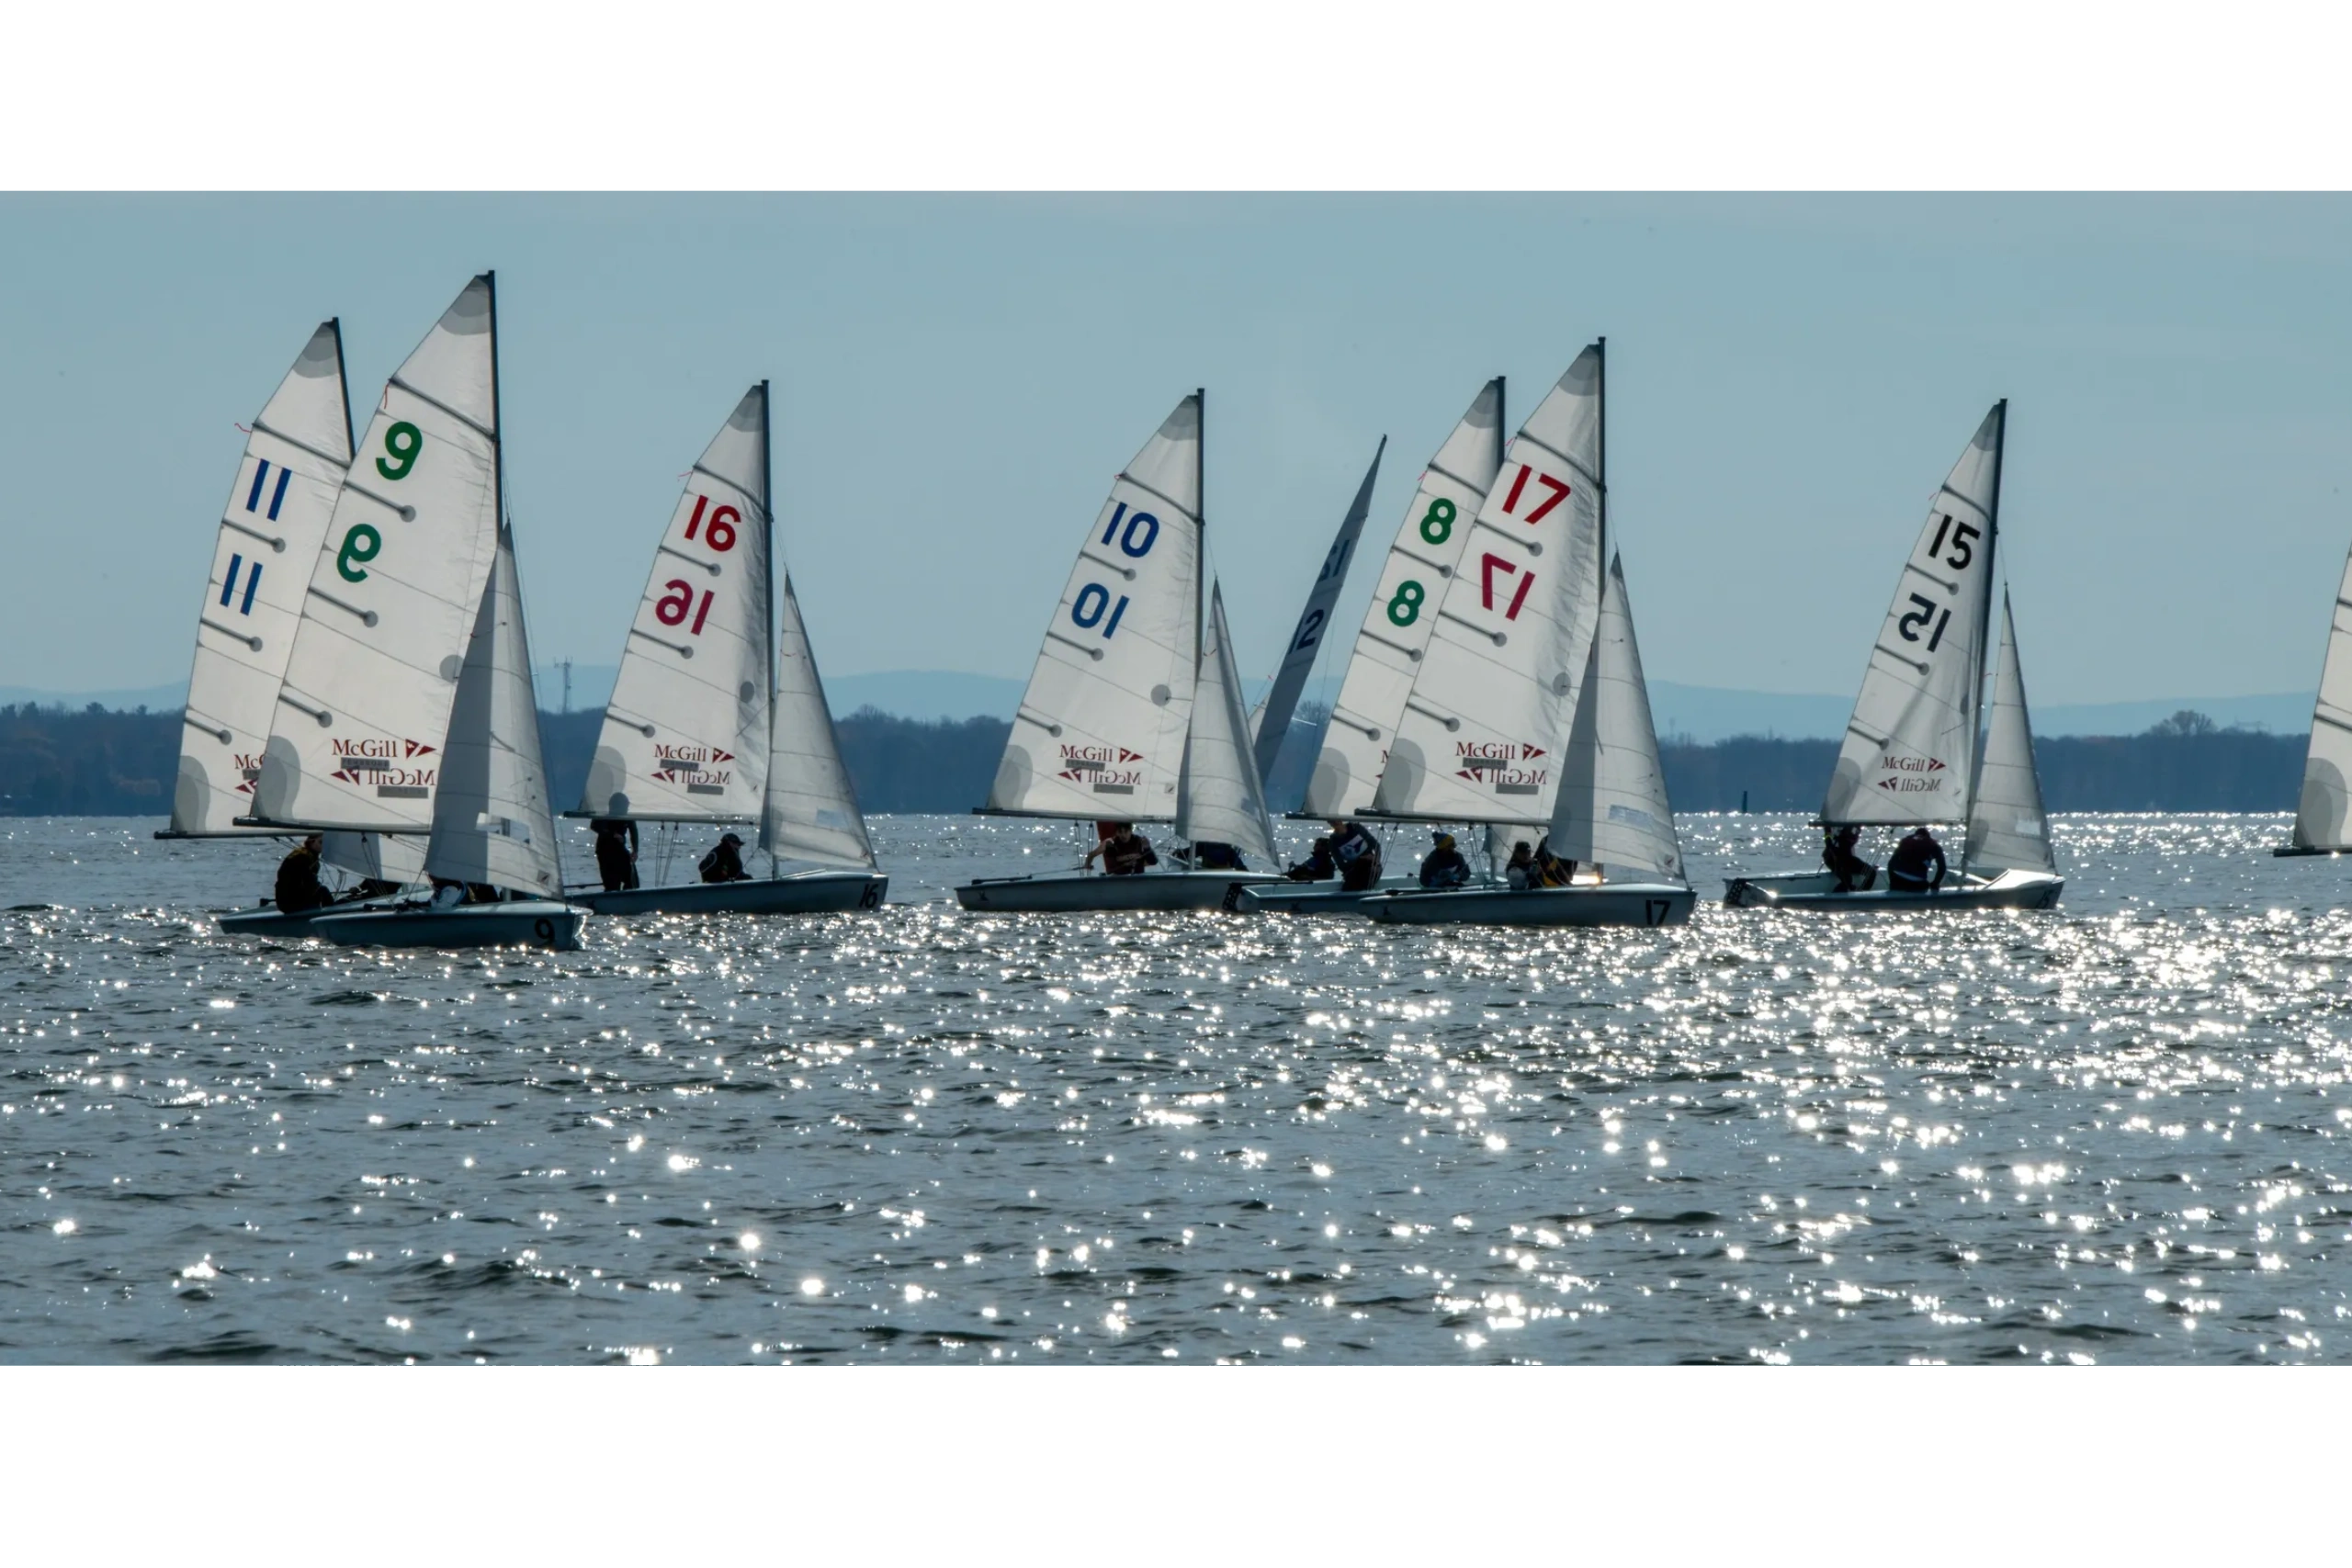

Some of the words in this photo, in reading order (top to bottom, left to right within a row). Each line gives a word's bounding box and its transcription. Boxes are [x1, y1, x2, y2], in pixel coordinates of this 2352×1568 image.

[376, 422, 423, 480] 9
[246, 458, 292, 522] 11
[1502, 464, 1571, 525] 17
[684, 495, 741, 551] 16
[1101, 502, 1159, 558] 10
[1419, 498, 1456, 545] 8
[1928, 513, 1981, 570] 15
[220, 553, 263, 615] 11
[1386, 580, 1425, 627] 8
[332, 739, 398, 758] McGill
[653, 744, 707, 761] McGill
[1059, 744, 1113, 762] McGill
[1455, 741, 1515, 760] McGill
[1882, 756, 1926, 772] McGill
[858, 884, 879, 908] 16
[1645, 899, 1671, 927] 17
[535, 919, 556, 945] 9
